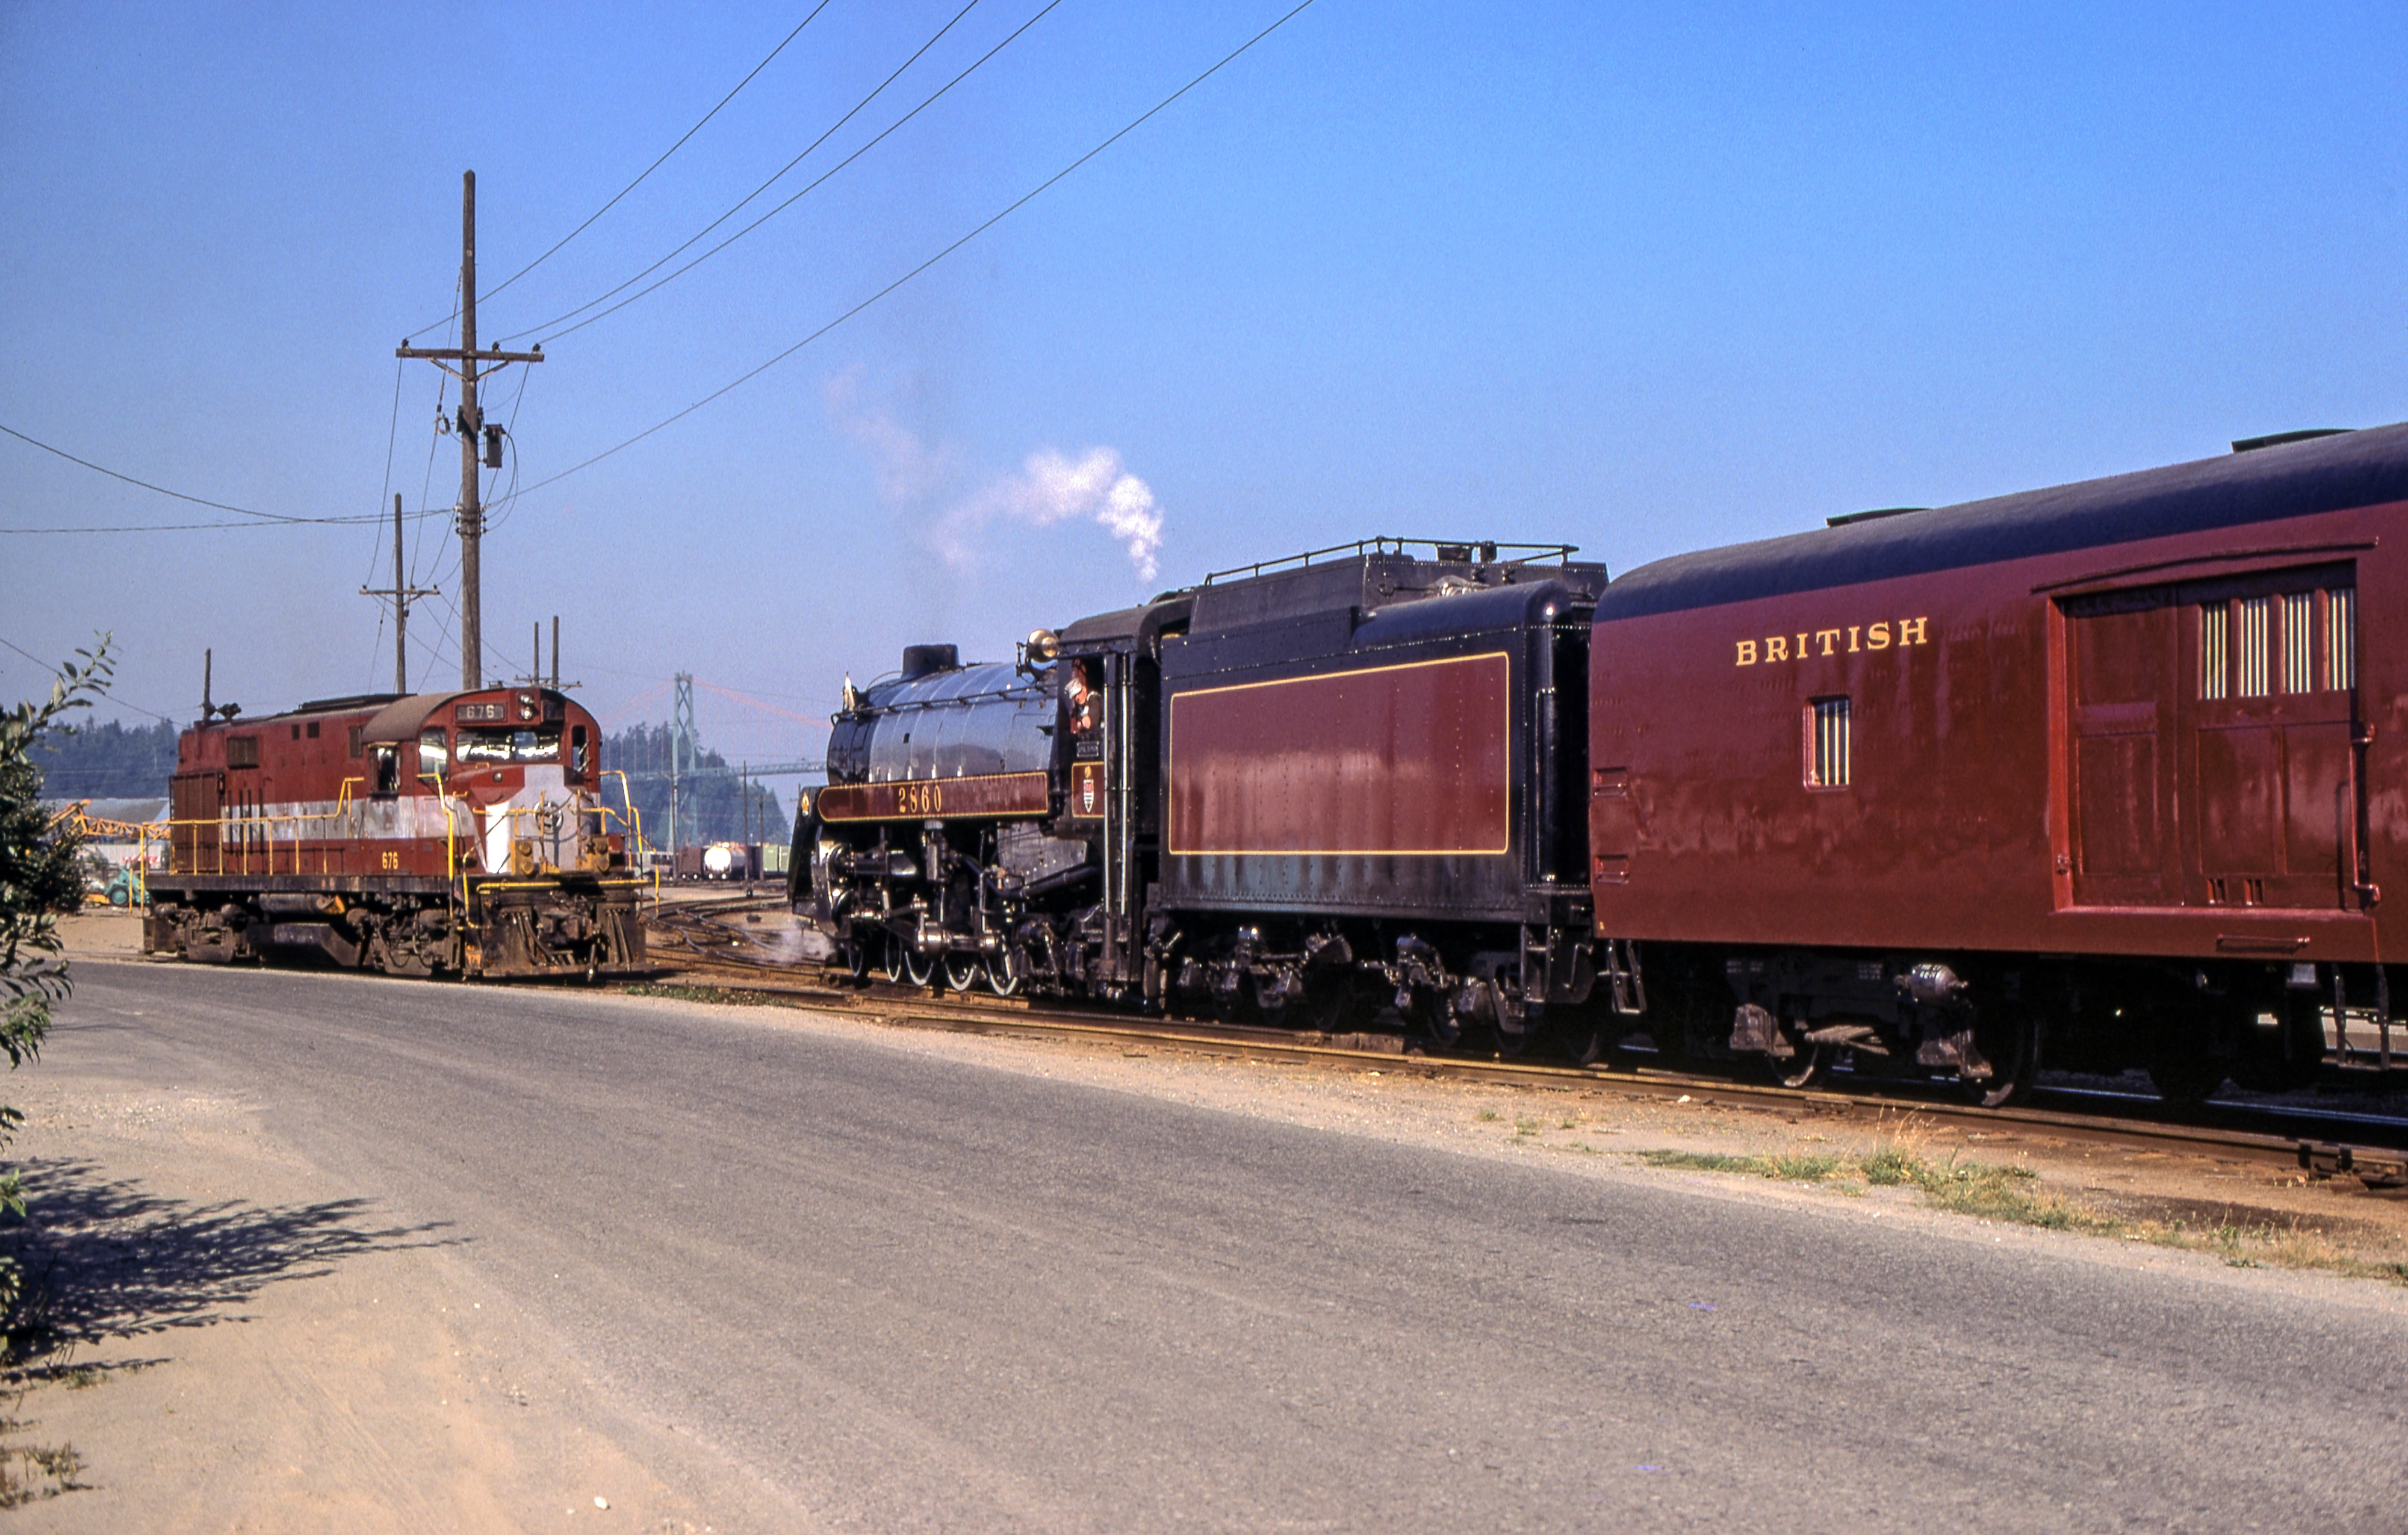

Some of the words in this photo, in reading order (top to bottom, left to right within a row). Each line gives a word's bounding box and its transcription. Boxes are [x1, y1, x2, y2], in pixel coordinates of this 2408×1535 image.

[1736, 617, 1927, 666] BRITISH
[467, 705, 494, 718] 676
[899, 785, 942, 813] 2860
[382, 852, 398, 869] 676
